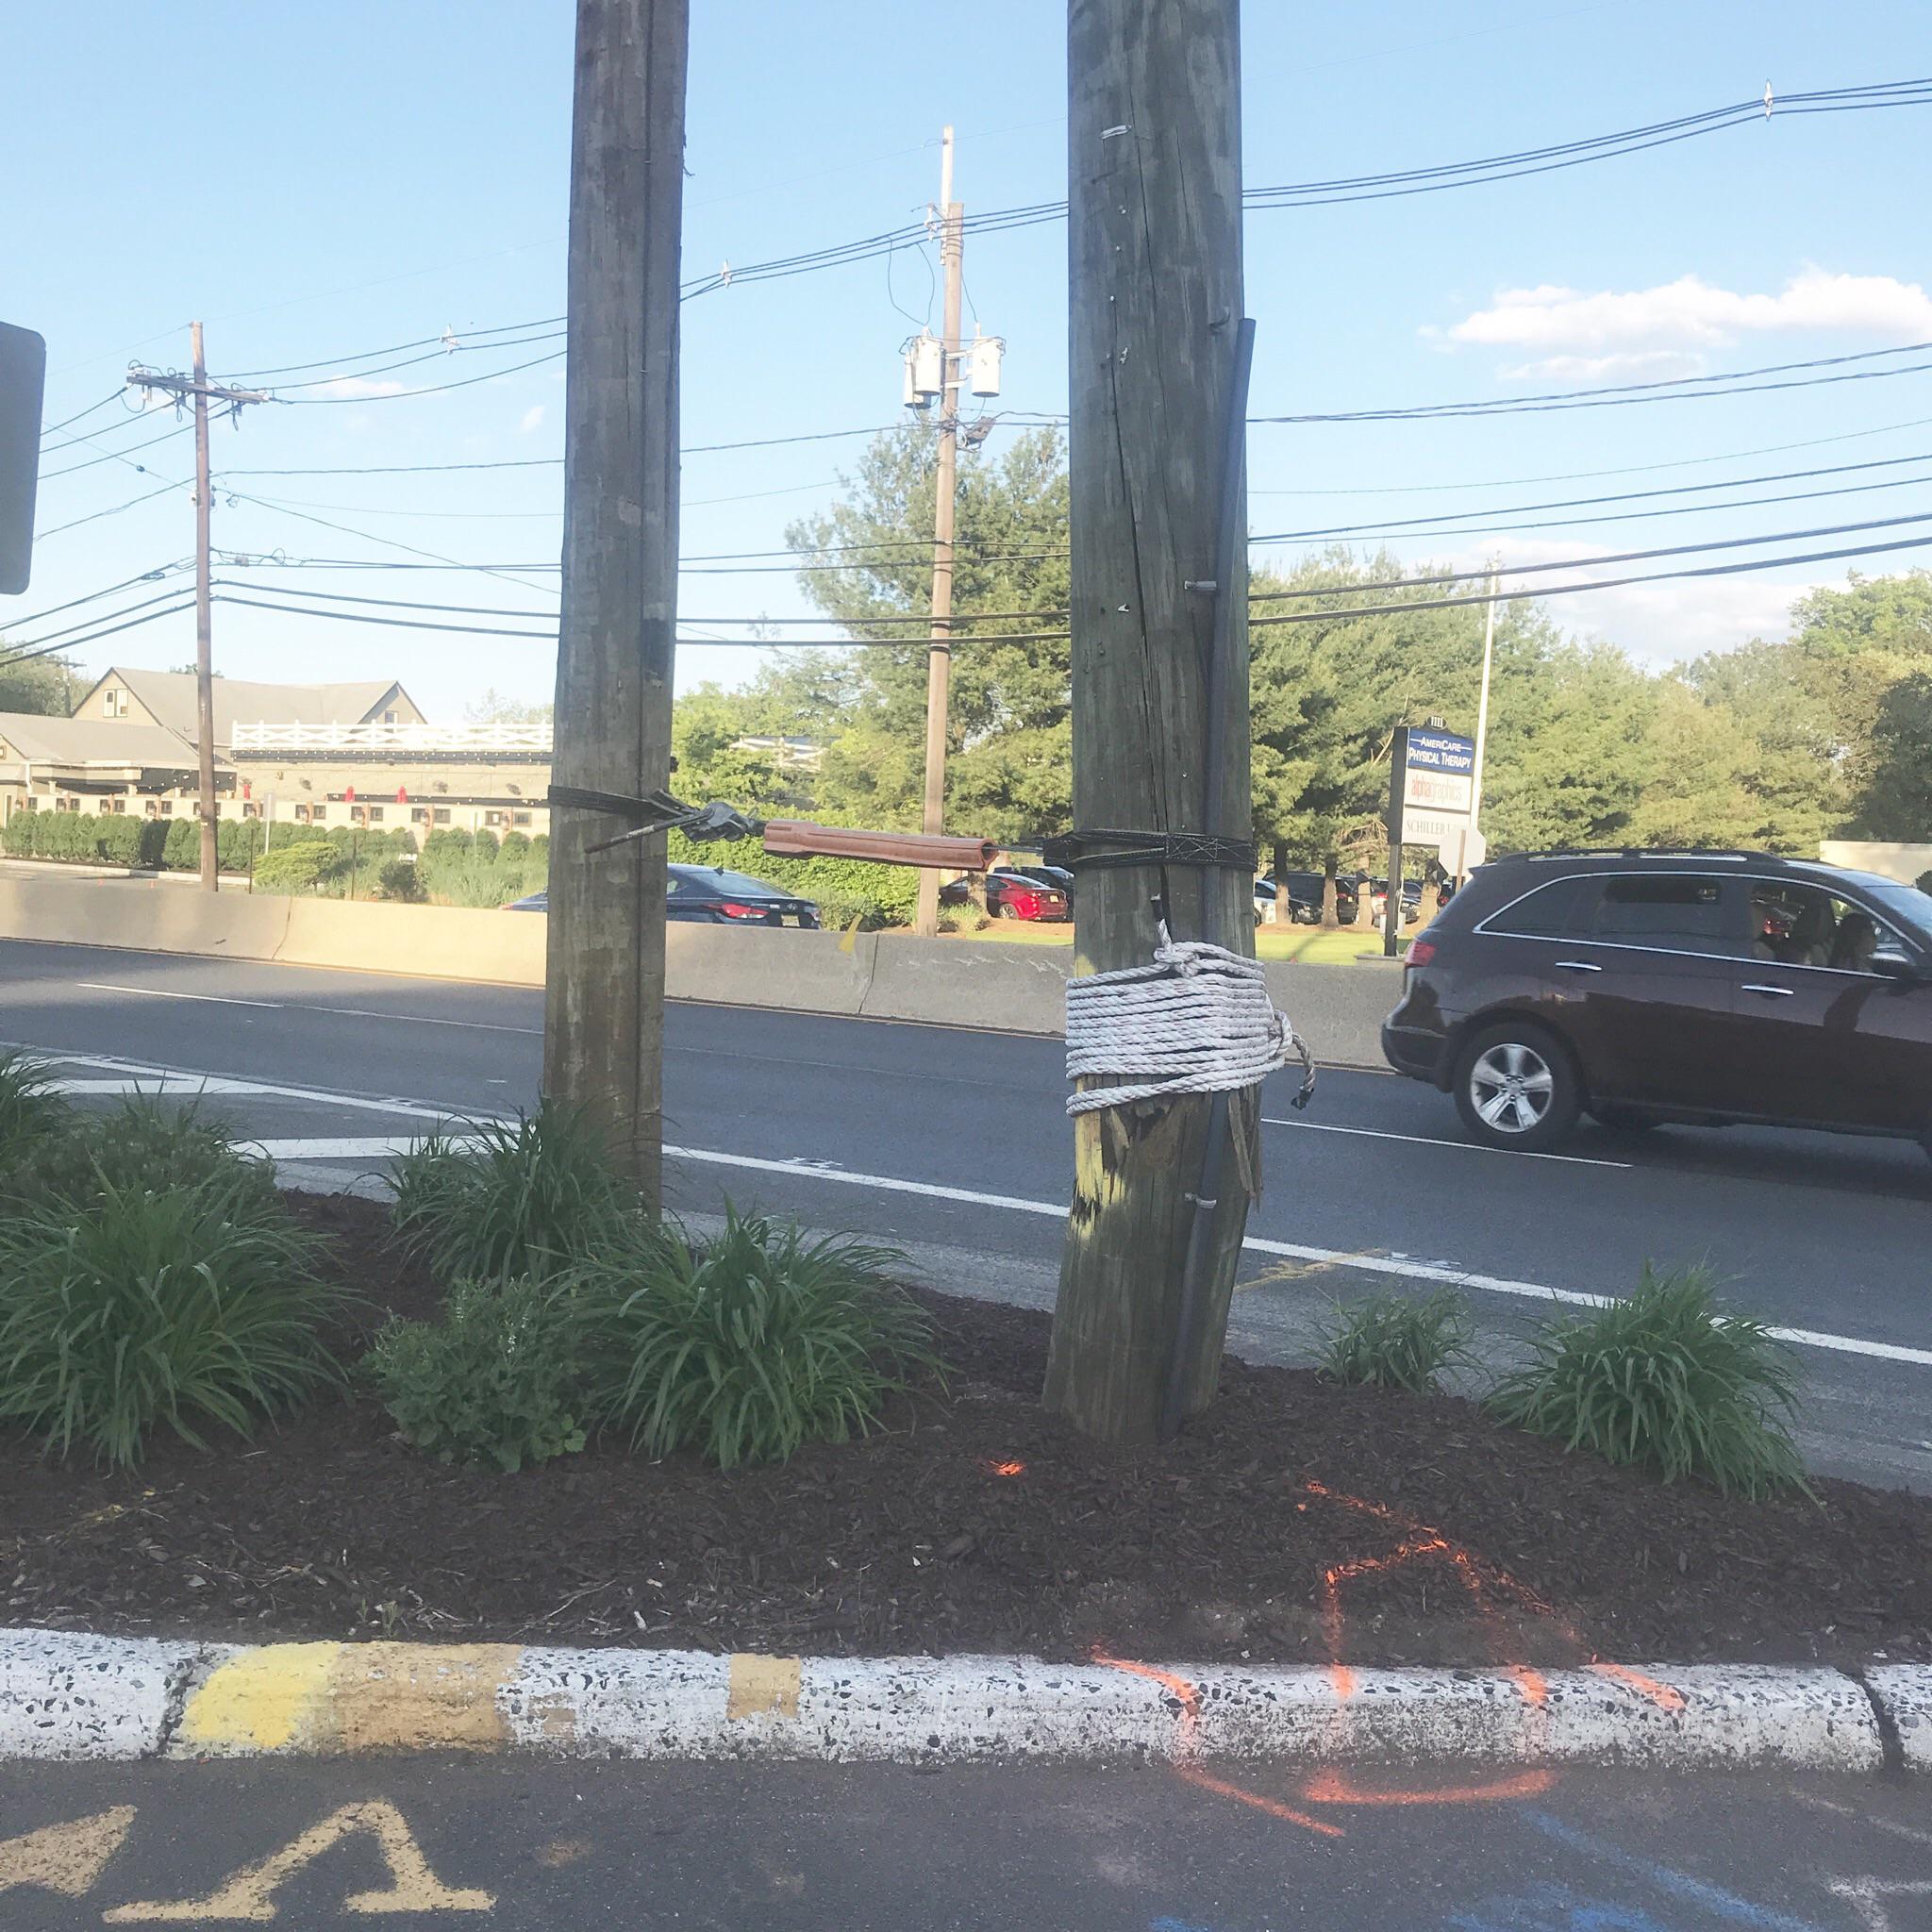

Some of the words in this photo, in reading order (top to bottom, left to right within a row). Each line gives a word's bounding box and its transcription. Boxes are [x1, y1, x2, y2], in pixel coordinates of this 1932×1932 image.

[1408, 747, 1441, 765] PHYSICAL
[1441, 753, 1472, 769] THERAPY
[1406, 819, 1445, 835] SCHILLER
